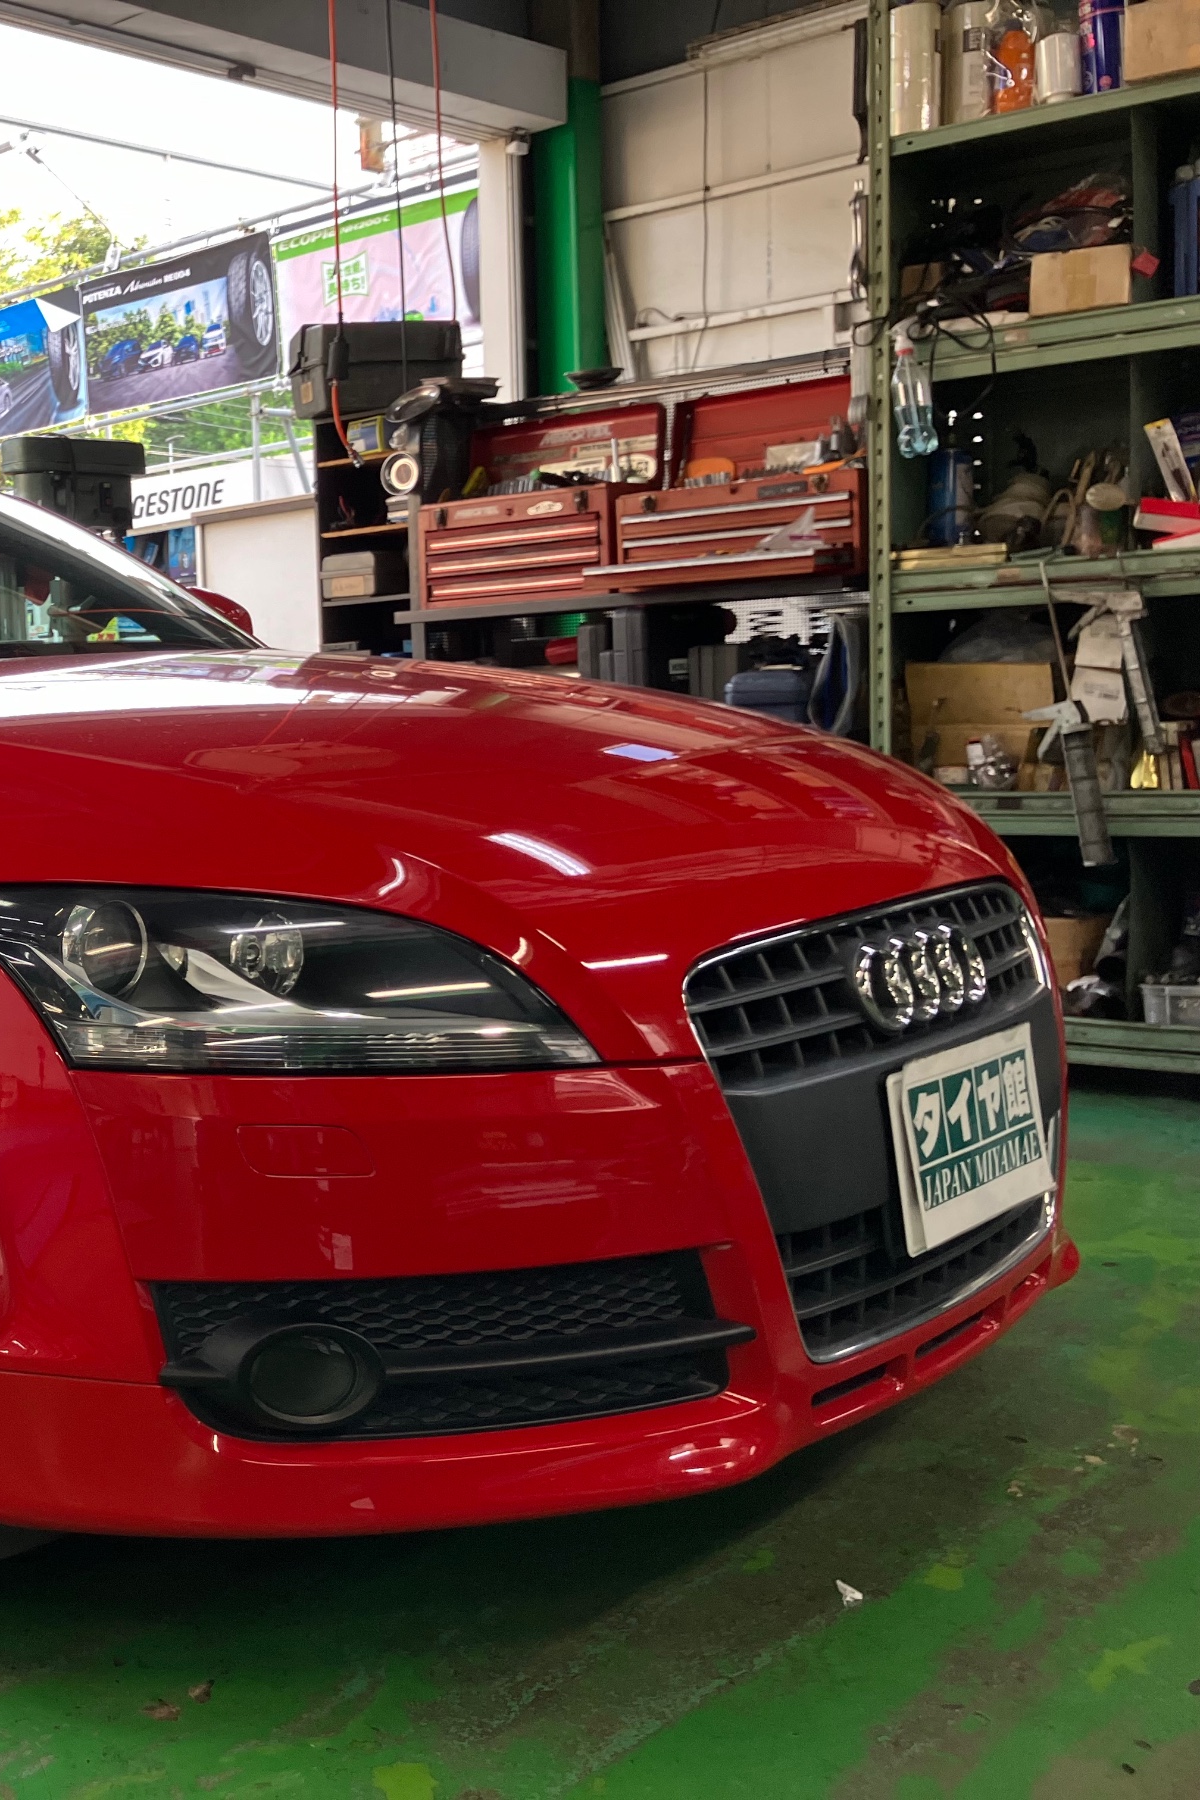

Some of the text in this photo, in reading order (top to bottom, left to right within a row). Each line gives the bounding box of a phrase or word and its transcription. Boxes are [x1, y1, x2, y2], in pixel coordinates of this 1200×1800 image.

[82, 285, 123, 305] POTENZA
[913, 1056, 1032, 1158] タイヤ館
[923, 1129, 1041, 1211] JAPAN MIYAMAE
